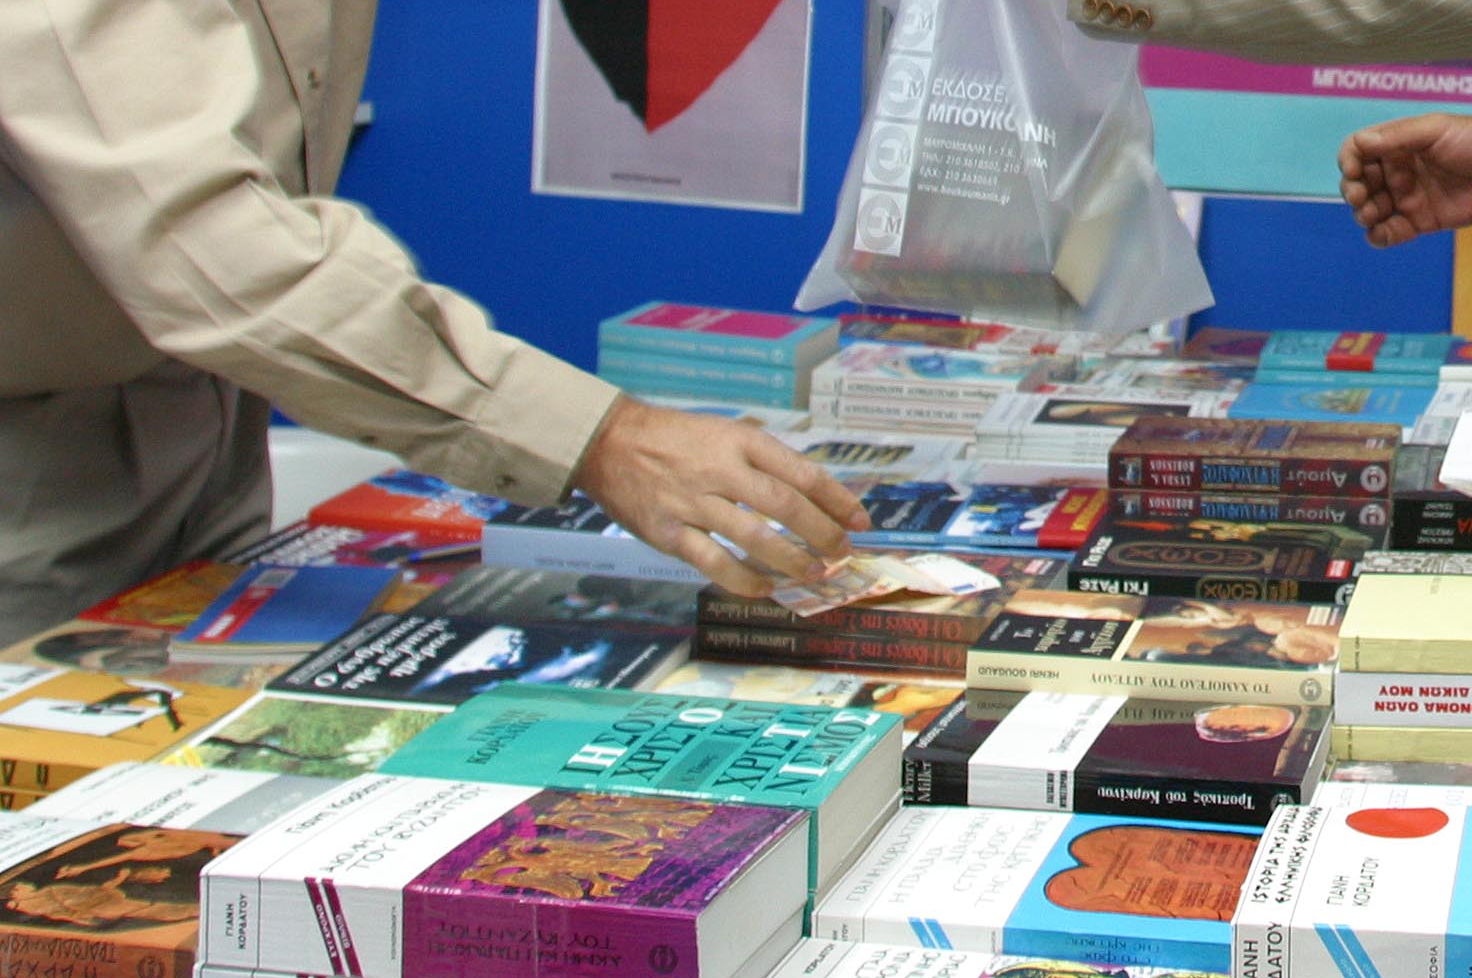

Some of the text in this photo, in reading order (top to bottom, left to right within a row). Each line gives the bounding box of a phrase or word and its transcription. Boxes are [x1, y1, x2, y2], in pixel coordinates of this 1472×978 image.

[931, 77, 1009, 103] ΕΚΔΟΣΕ
[1124, 581, 1149, 596] ΓΚΙ
[977, 666, 1060, 680] HENRI GOUGAUD
[1151, 676, 1177, 690] ΤΟΥ
[1179, 678, 1250, 693] ΧΑΜΟΓΕΛΟ
[1252, 683, 1271, 695] ΤΟ
[1379, 685, 1414, 698] ΜΟΥ
[1419, 686, 1470, 699] ΔΙΚΩΝ
[1374, 700, 1421, 714] ΟΛΩΝ
[722, 703, 787, 740] ΚΑΙ
[559, 699, 688, 777] ΙΗΣΟΥΣ
[711, 707, 834, 792] ΧΡΙΣΤΙΑ
[762, 708, 882, 796] ΝΙΣΜΟΣ
[918, 760, 931, 802] Miller
[1096, 784, 1163, 805] Καρκίνου
[1192, 788, 1256, 812] Τροπικός
[1249, 806, 1300, 903] ΙΣΤΟΡΙΑ ΤΗΣ ΑΡΧΑΙΑ
[1321, 874, 1356, 905] ΓΙΑΝΗ
[1341, 856, 1389, 906] ΚΟΡΔΑΤΟΥ
[225, 903, 233, 937] ΓΙΑΝΗ
[238, 894, 248, 950] ΚΟΡΔΑΤΟΥ
